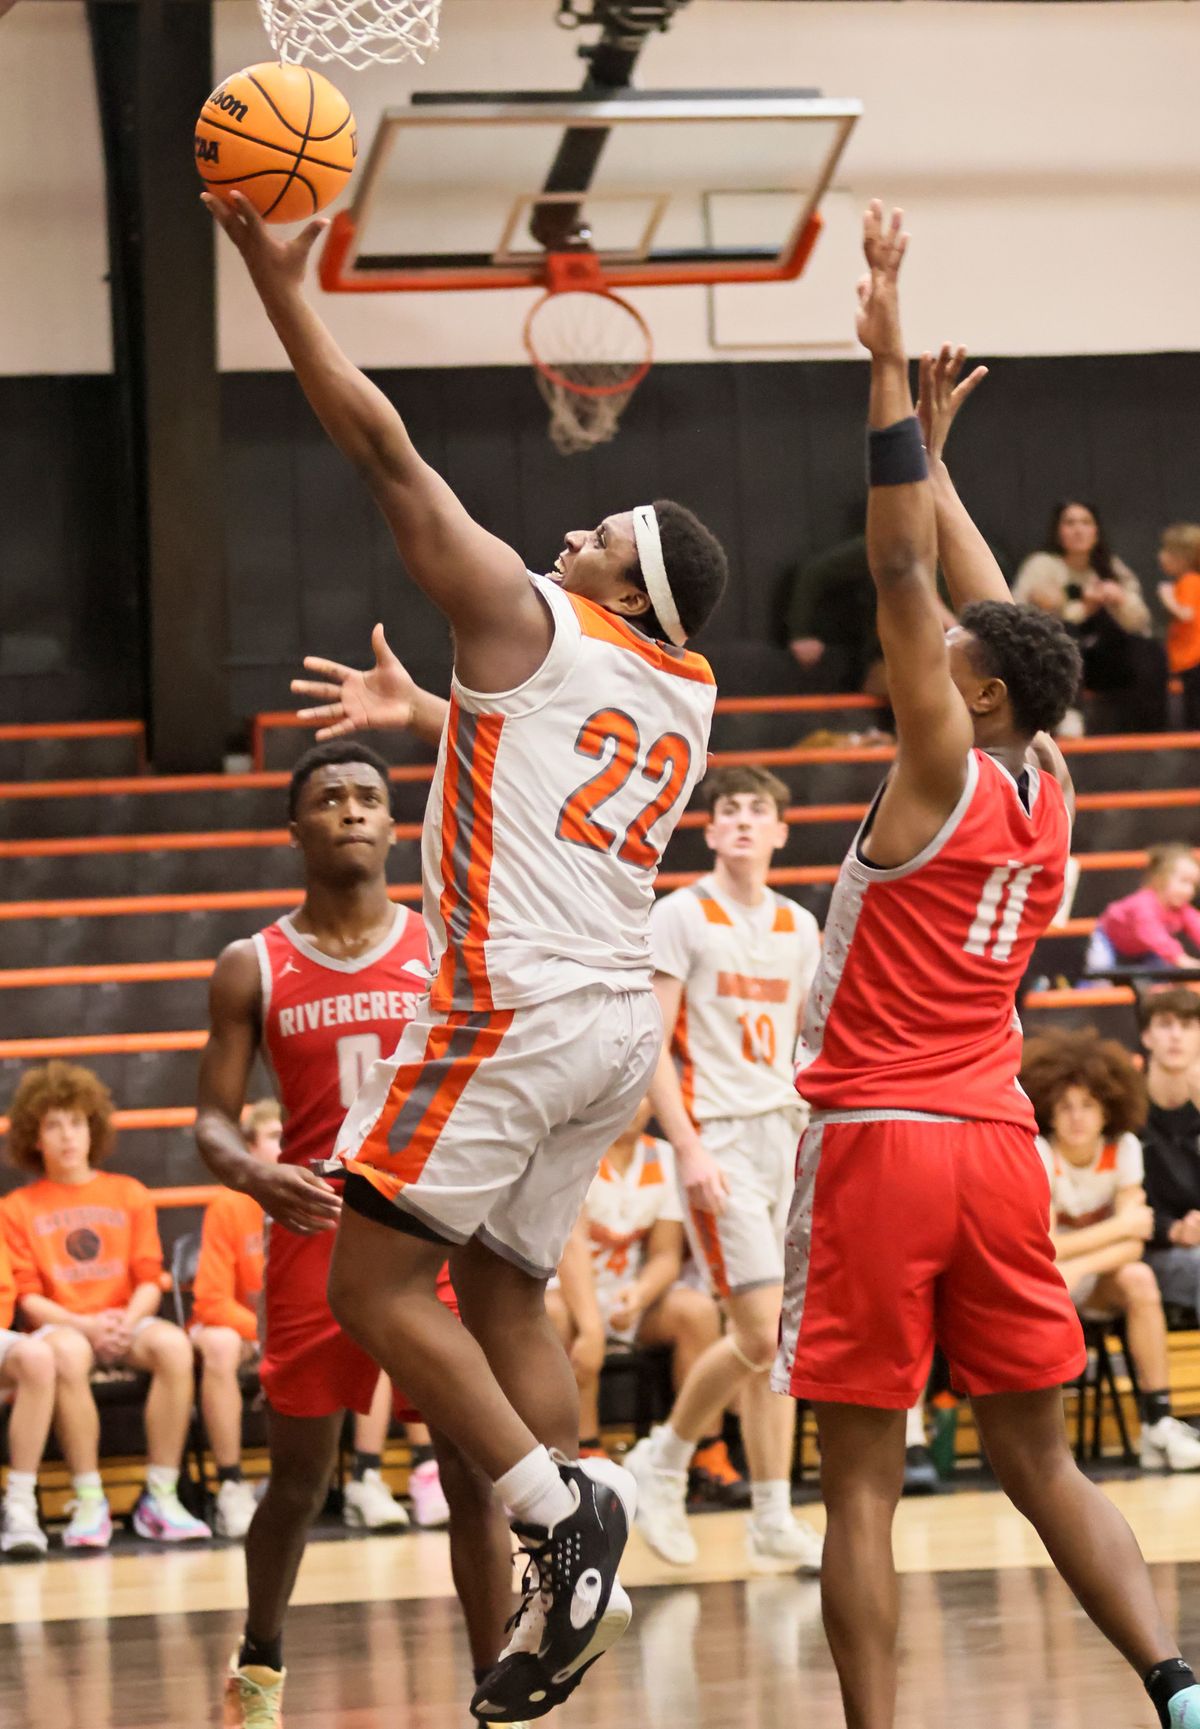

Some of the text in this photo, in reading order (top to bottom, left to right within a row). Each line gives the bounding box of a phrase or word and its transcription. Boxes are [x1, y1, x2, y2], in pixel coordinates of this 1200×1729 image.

[555, 707, 692, 871] 22
[962, 859, 1044, 963] 11
[279, 991, 424, 1037] RIVERCRES
[336, 1033, 381, 1109] 0
